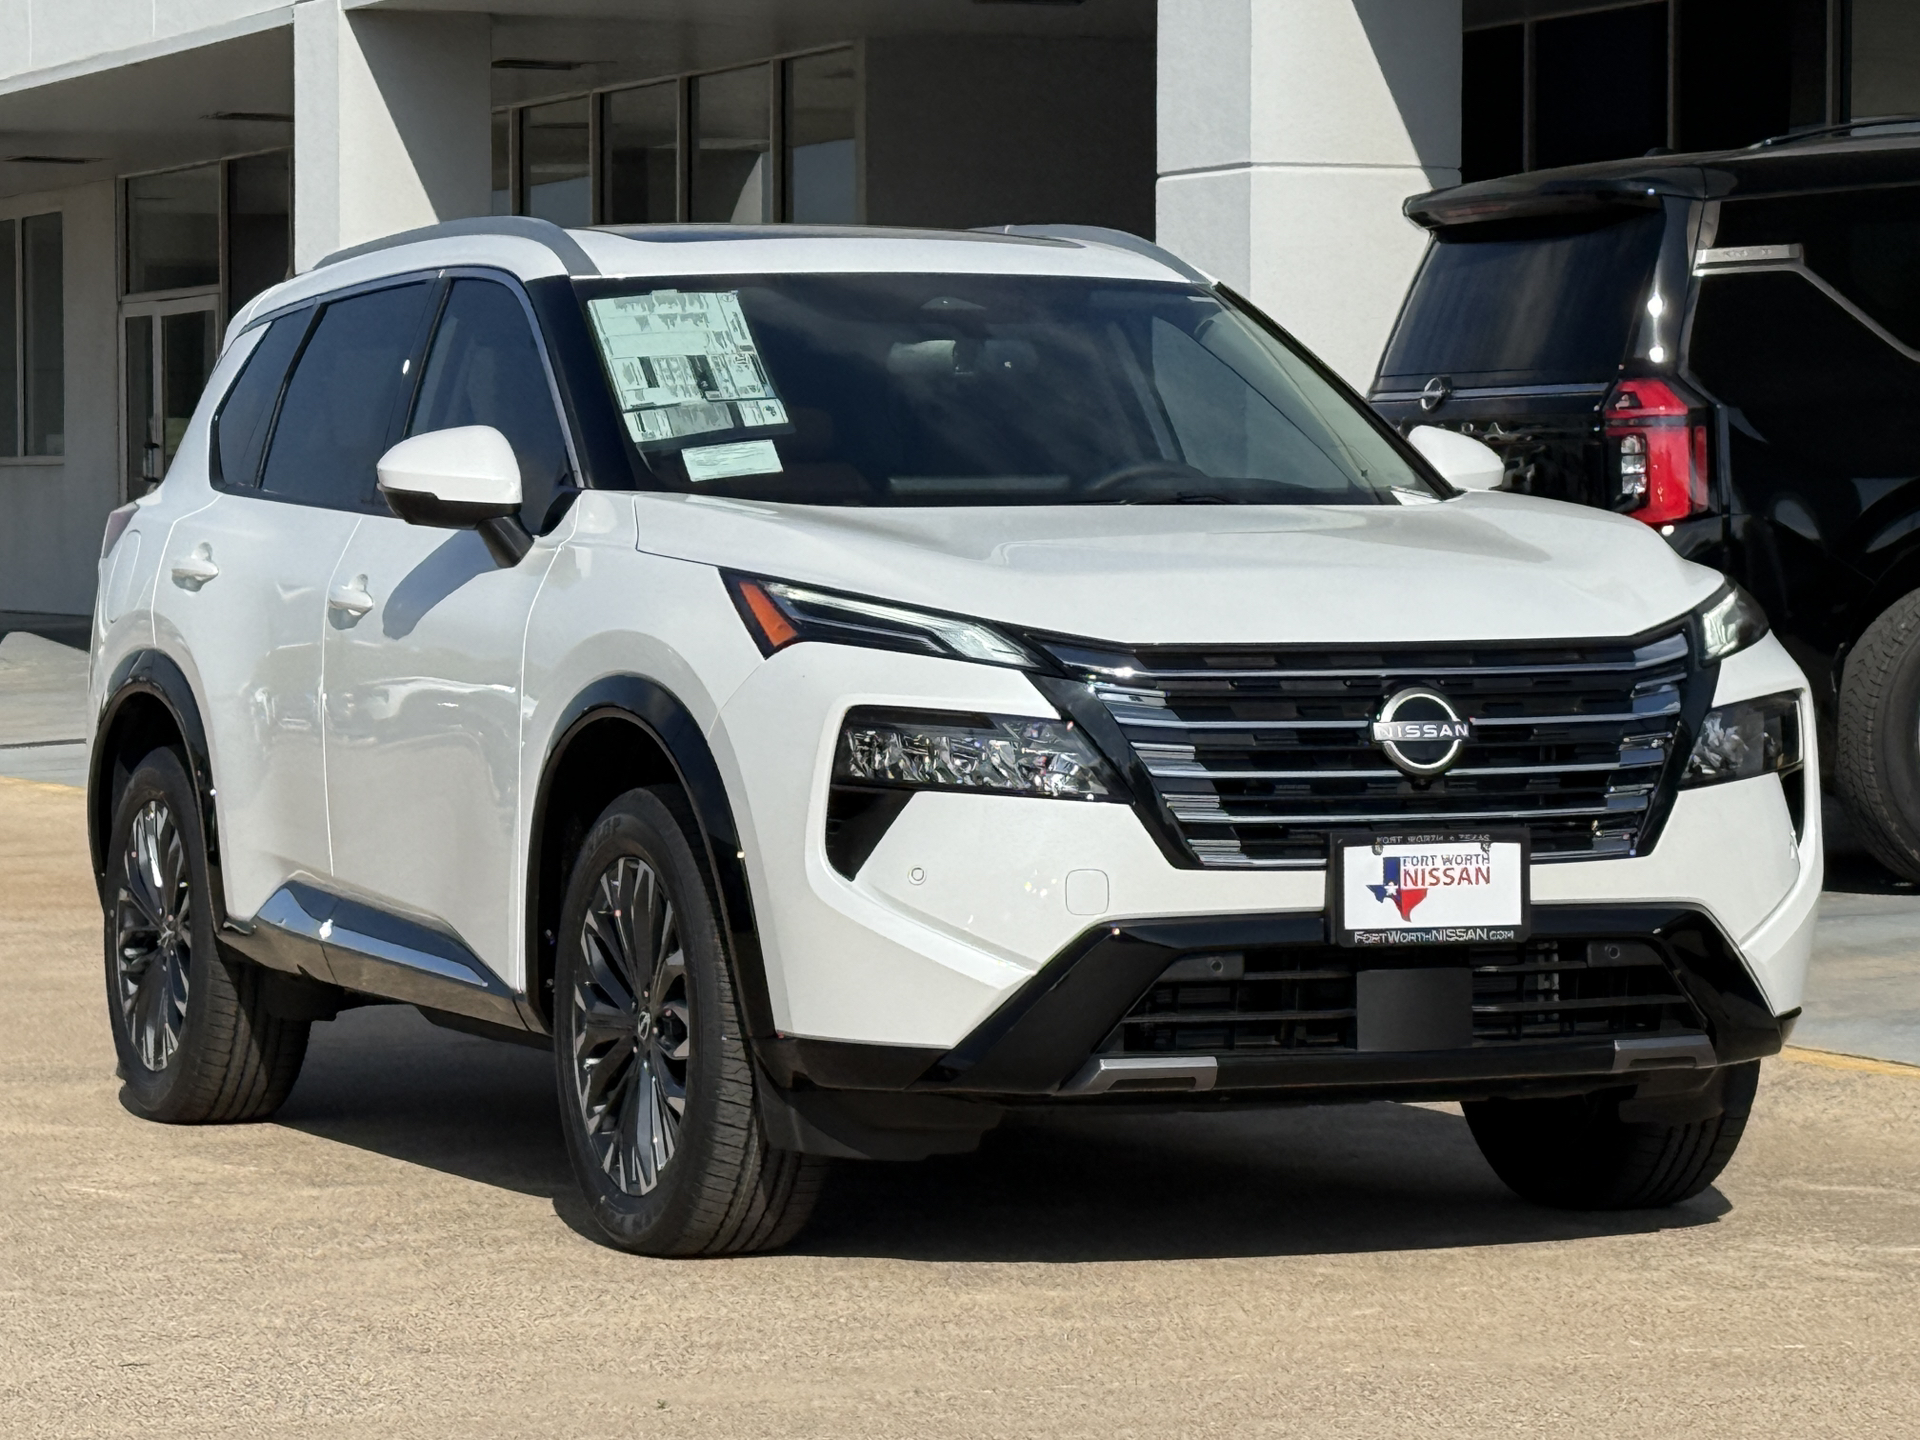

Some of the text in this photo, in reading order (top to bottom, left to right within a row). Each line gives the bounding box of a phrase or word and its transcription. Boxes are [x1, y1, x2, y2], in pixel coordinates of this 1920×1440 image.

[1377, 723, 1469, 738] NISSAN
[1402, 853, 1491, 867] FORT WORTH
[1403, 866, 1491, 887] NISSAN
